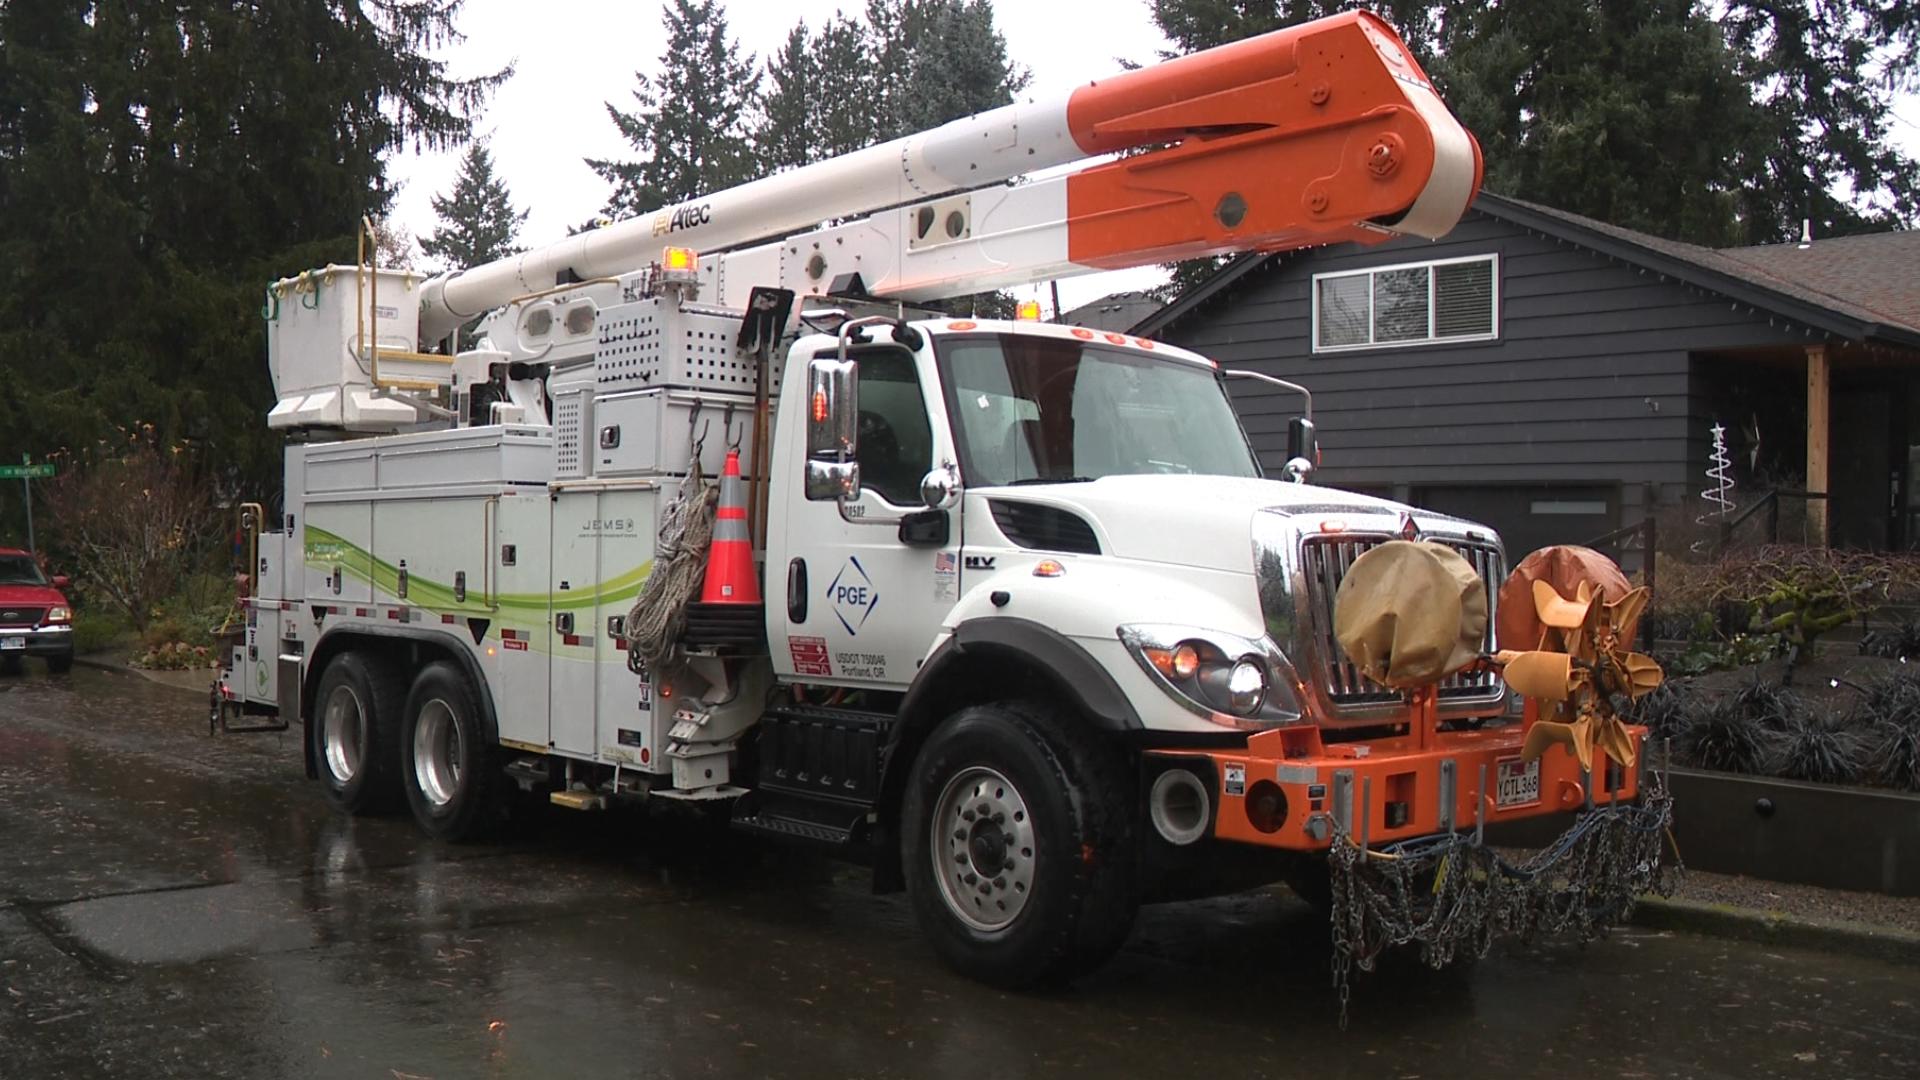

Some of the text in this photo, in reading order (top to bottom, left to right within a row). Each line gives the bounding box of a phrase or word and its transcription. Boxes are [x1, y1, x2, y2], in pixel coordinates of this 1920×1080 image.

[670, 204, 711, 233] Altec
[582, 519, 624, 530] JEMS
[965, 556, 997, 567] HV
[837, 586, 867, 605] PGE
[835, 652, 860, 665] USDOT
[873, 667, 886, 678] OR
